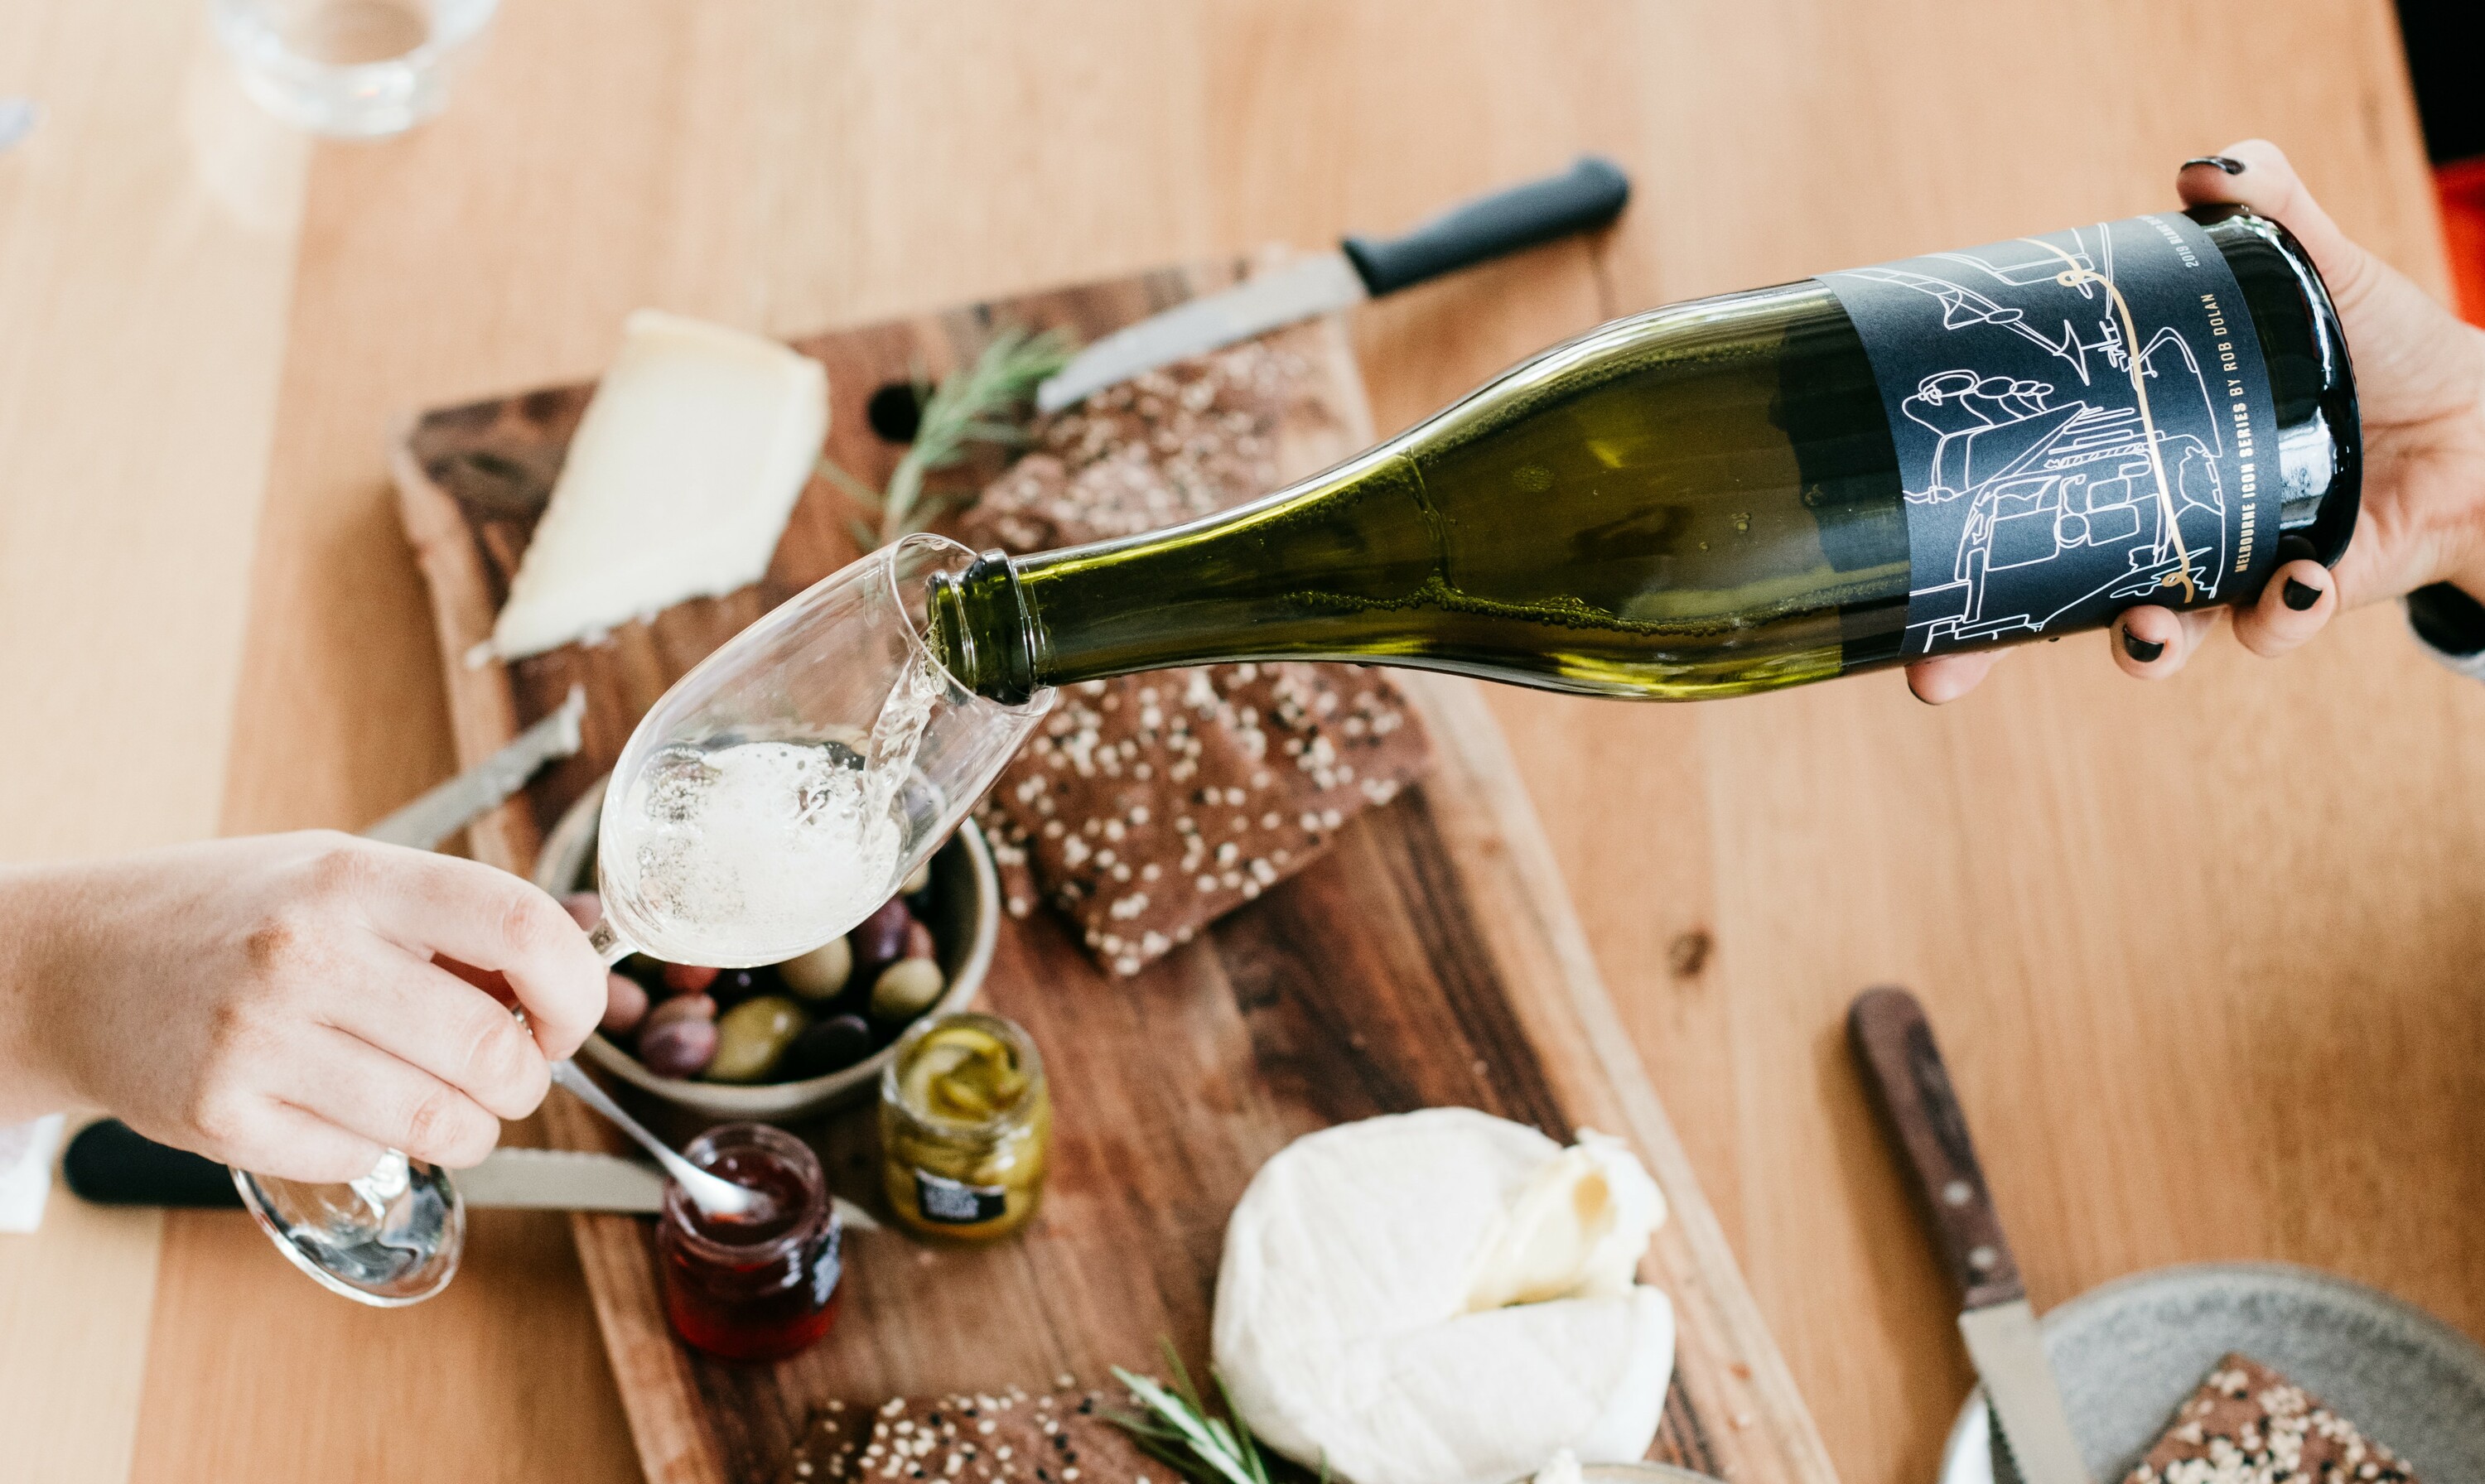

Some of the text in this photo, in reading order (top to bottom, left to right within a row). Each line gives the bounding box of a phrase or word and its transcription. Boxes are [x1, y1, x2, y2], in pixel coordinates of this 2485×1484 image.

[2175, 245, 2199, 268] 2019
[2200, 293, 2256, 573] MELBOURNE ICON SERIES BY ROB DOLAN
